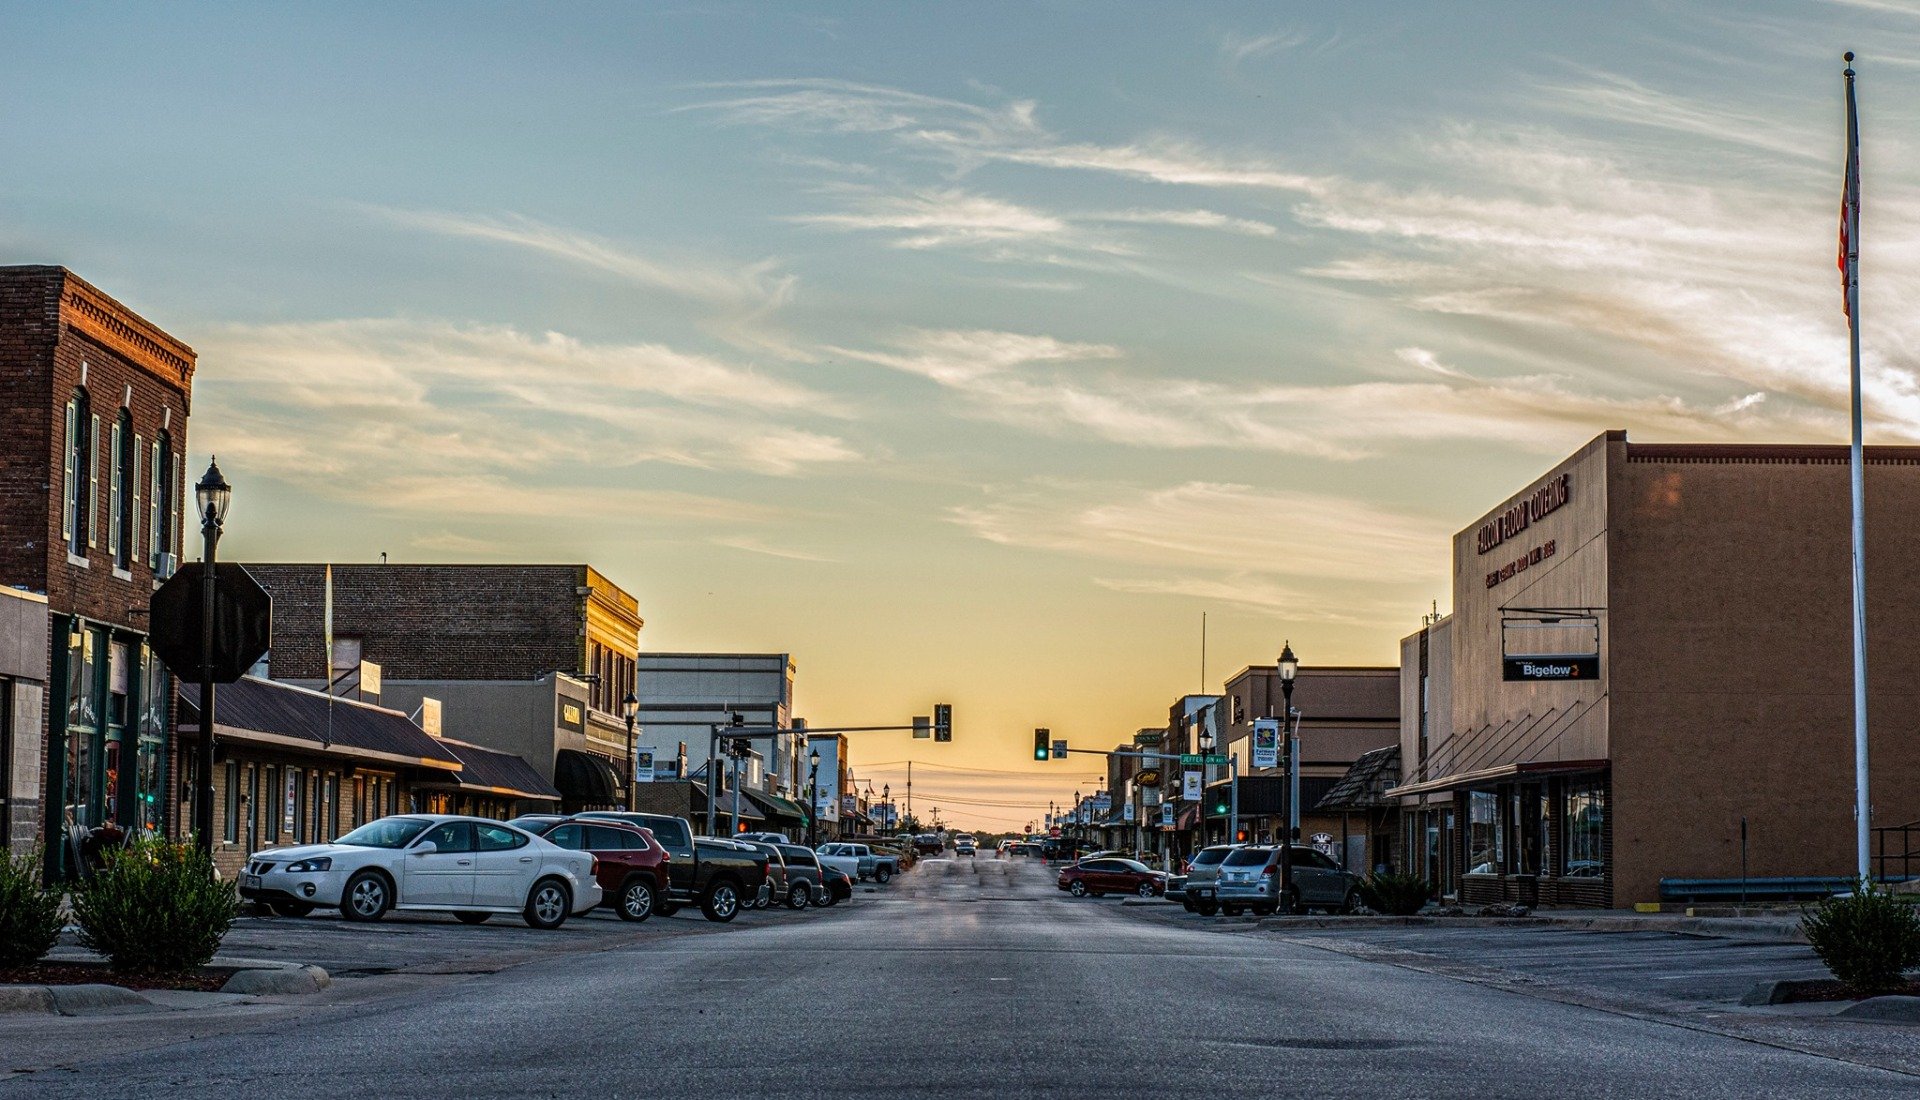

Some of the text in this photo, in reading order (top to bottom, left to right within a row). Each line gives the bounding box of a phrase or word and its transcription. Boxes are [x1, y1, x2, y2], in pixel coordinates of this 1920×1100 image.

[1478, 473, 1568, 555] FALCON FLOOR COVERING
[1523, 664, 1571, 677] Bigelow
